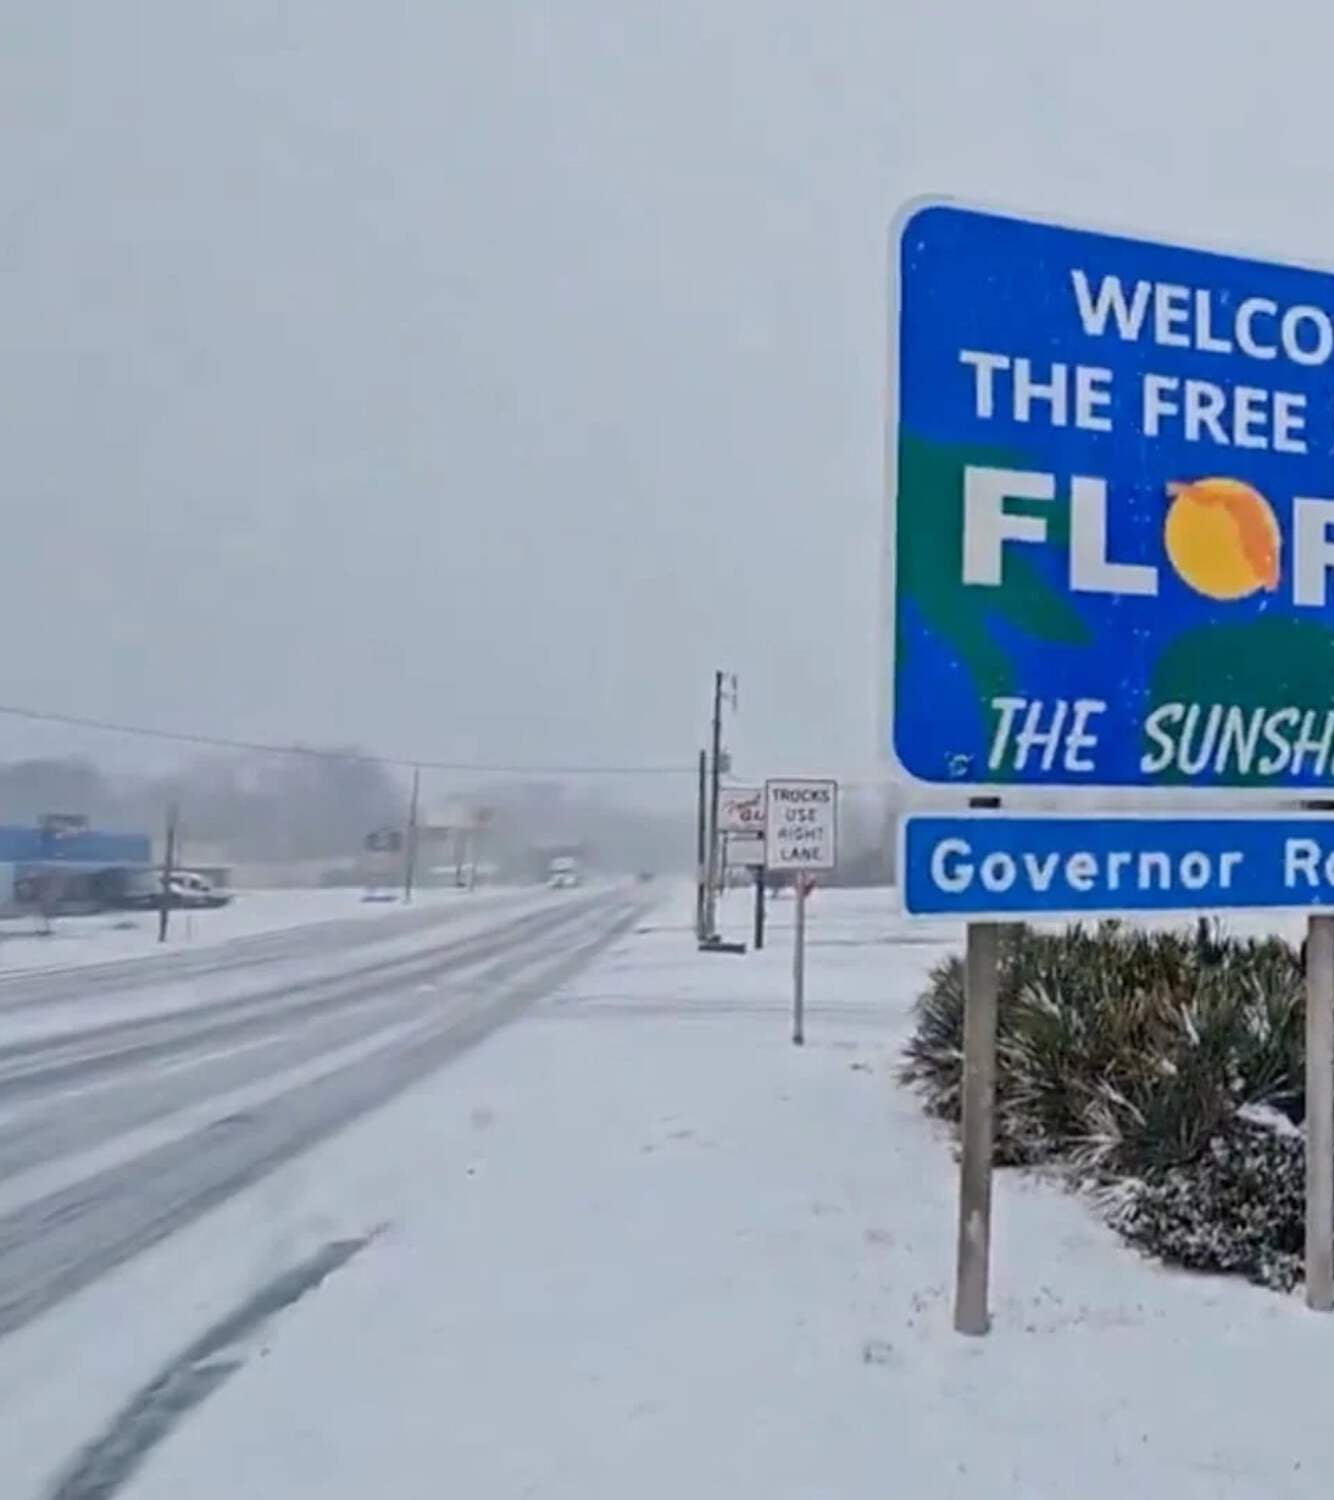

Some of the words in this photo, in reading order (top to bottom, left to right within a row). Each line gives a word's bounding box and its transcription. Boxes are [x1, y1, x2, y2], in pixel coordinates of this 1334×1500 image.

[959, 350, 1113, 432] THE
[1143, 373, 1307, 454] FREE
[987, 697, 1107, 773] THE
[773, 788, 830, 803] TRUCKS
[786, 808, 817, 822] USE
[778, 827, 823, 841] RIGHT
[780, 847, 821, 861] LANE
[931, 838, 1243, 894] Governor
